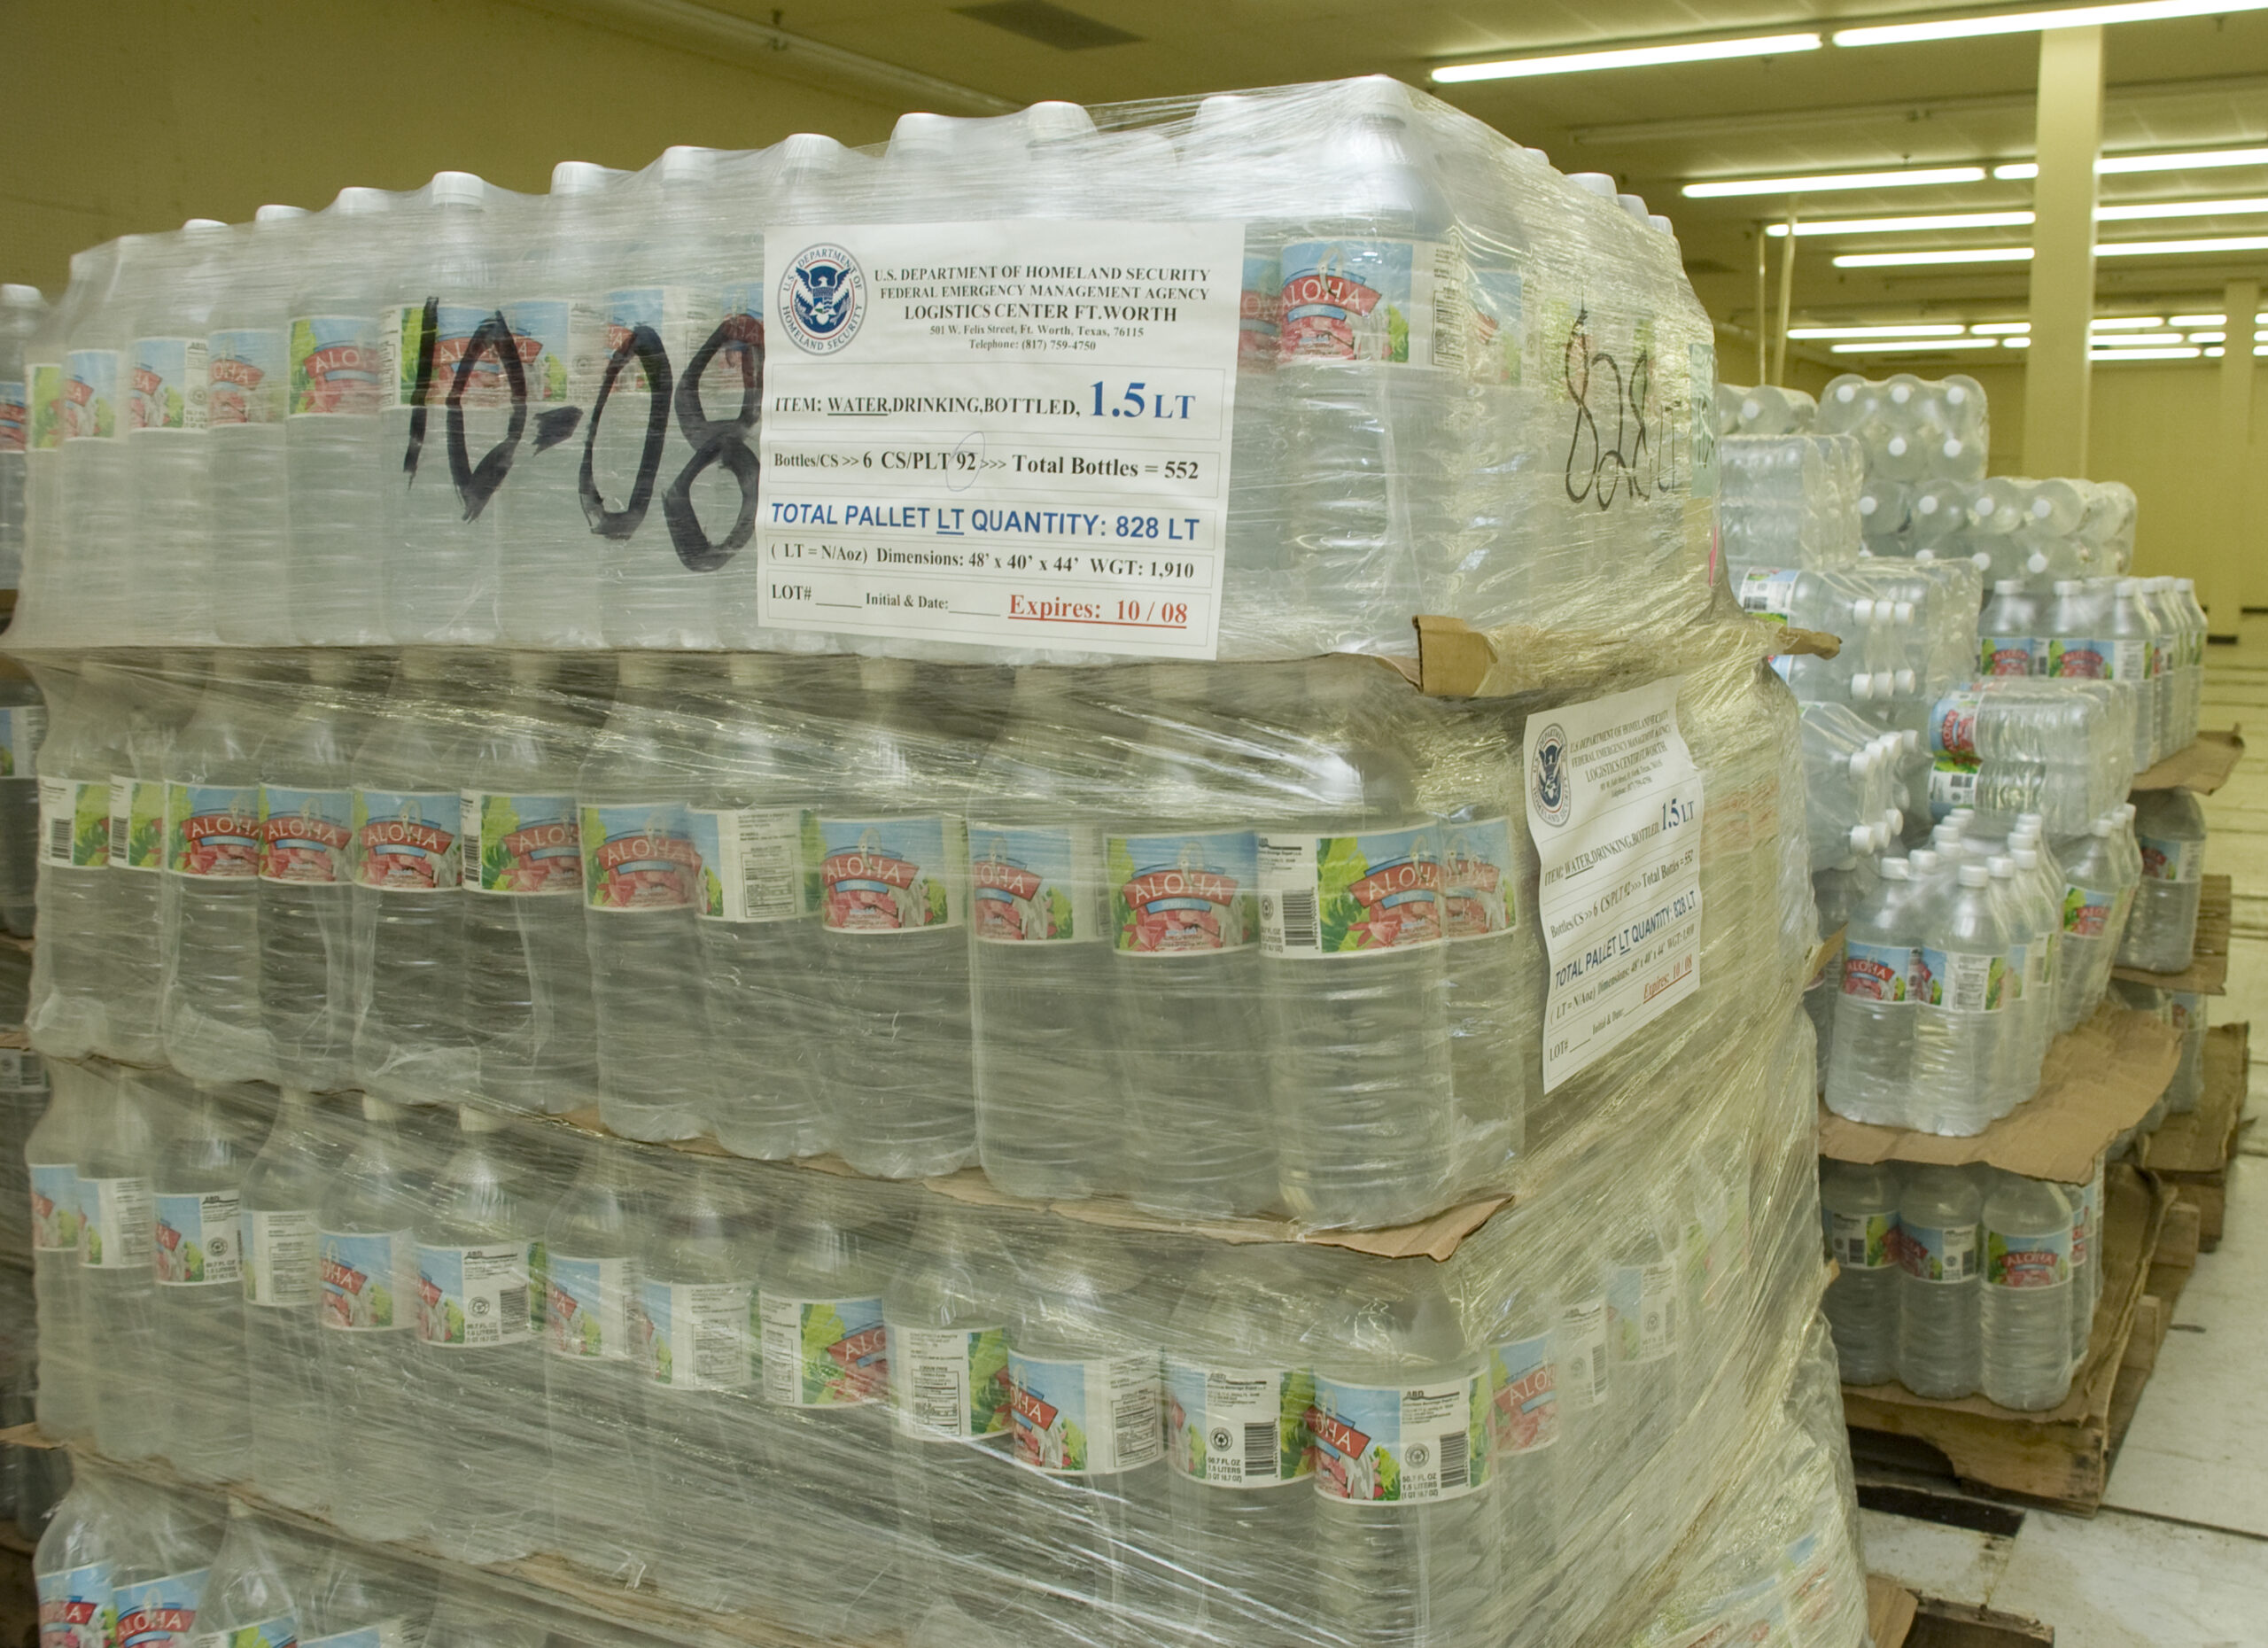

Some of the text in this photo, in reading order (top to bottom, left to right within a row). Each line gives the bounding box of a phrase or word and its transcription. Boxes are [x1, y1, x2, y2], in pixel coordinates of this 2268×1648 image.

[797, 248, 858, 274] DEPARTMENT
[854, 276, 863, 291] OF
[874, 265, 1210, 282] U.S. DEPARTMENT OF HOMELAND SECURITY
[881, 284, 1209, 300] FEDERAL EMERGENCY MANAGEMENT AGENCY
[1282, 278, 1362, 312] ALOHA
[782, 305, 824, 351] HOMELAND
[827, 304, 863, 350] SECURITY
[905, 303, 1177, 322] LOGISTICS CENTER FT.WORTH
[929, 323, 1145, 338] 501 W. Felix Street, Ft. Worth, Texas, 76115
[969, 338, 1097, 352] Telephone: (817) 759-4750
[774, 397, 822, 412] ITEM:
[1090, 381, 1146, 418] 1.5
[1153, 393, 1197, 419] LT
[403, 296, 765, 572] 10-08
[773, 452, 839, 468] Bottles/CS
[863, 451, 873, 469] 6
[881, 451, 951, 470] CS/PLT
[956, 452, 975, 470] 92
[1012, 454, 1063, 473] Total
[1071, 456, 1138, 478] Bottles
[1164, 461, 1199, 479] 552
[772, 502, 1200, 540] TOTAL PALLET LT QUANTITY: 828 LT
[784, 542, 804, 558] LT
[876, 547, 964, 567] Dimensions:
[994, 557, 1002, 569] x
[1039, 559, 1048, 571] x
[1090, 557, 1144, 577] WGT:
[1150, 561, 1194, 579] 1,910
[772, 583, 812, 601] LOT#
[866, 592, 900, 607] Initial
[904, 595, 913, 608] &
[1009, 594, 1101, 620] Expires:
[1116, 599, 1140, 621] 10
[1161, 602, 1188, 625] 08
[1662, 798, 1681, 831] 1.5
[1681, 800, 1695, 823] LT
[268, 820, 338, 844] ALOHA
[367, 823, 439, 850] ALOHA
[826, 856, 901, 883] ALOHA
[981, 863, 1024, 894] OHA
[1368, 866, 1441, 901] ALOHA
[1642, 867, 1660, 889] Total
[1134, 873, 1223, 905] ALOHA
[1555, 964, 1584, 991] TOTAL
[1585, 936, 1617, 972] PALLET
[1619, 928, 1631, 955] LT
[1631, 906, 1674, 944] QUANTITY:
[1686, 890, 1697, 913] LT
[1846, 960, 1886, 980] ALOHA
[2006, 1253, 2054, 1267] ALOHA
[844, 1329, 886, 1362] ALO
[1010, 1384, 1042, 1423] OHA
[1315, 1412, 1351, 1453] OHA
